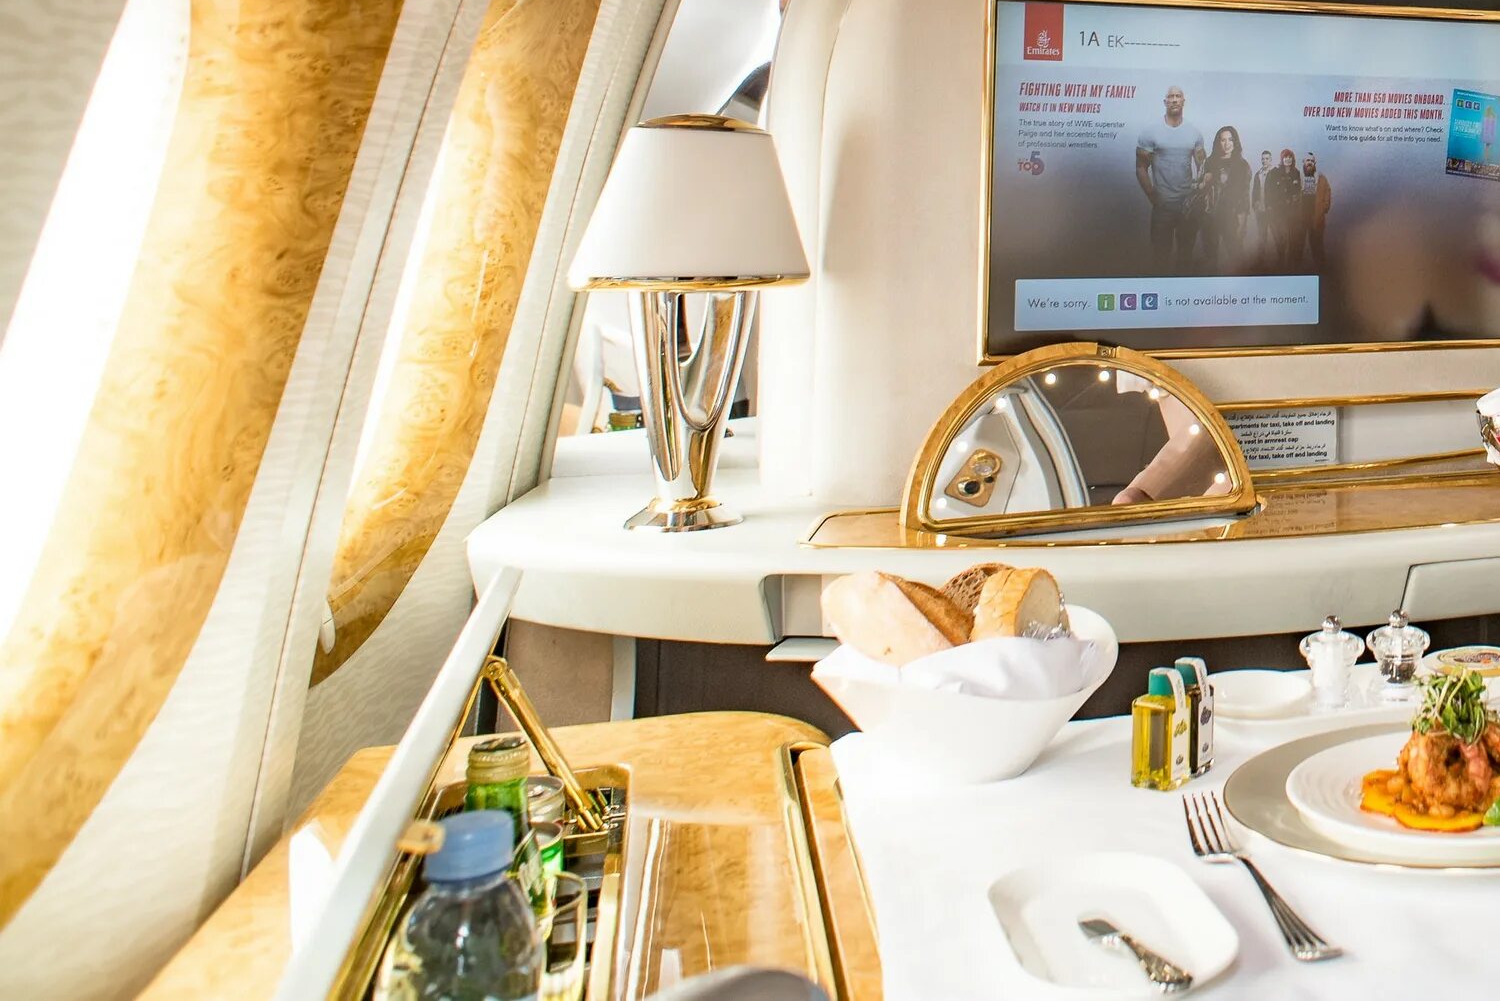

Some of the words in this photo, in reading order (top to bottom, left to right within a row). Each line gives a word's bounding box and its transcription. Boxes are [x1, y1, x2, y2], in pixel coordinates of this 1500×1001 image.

[1079, 31, 1100, 47] 1A
[1027, 46, 1060, 56] Emirates
[1019, 82, 1061, 97] FIGHTING
[1064, 83, 1088, 97] WITH
[1090, 84, 1103, 98] MY
[1105, 85, 1136, 98] FAMILY
[1334, 91, 1352, 102] MORE
[1354, 92, 1371, 103] THAN
[1387, 93, 1412, 104] MOVIES
[1414, 94, 1446, 105] ONBOARD.
[1019, 101, 1040, 112] WATCH
[1042, 102, 1049, 112] IT
[1050, 103, 1057, 112] IN
[1058, 103, 1074, 113] NEW
[1076, 103, 1101, 114] MOVIES
[1303, 106, 1320, 117] OVER
[1322, 107, 1335, 117] 100
[1337, 107, 1352, 118] NEW
[1354, 107, 1378, 118] MOVIES
[1380, 108, 1401, 119] ADDED
[1403, 109, 1418, 119] THIS
[1419, 109, 1444, 120] MONTH.
[1019, 119, 1032, 127] The
[1048, 120, 1065, 129] story
[1095, 121, 1126, 129] superstar
[1018, 130, 1038, 138] Paige
[1053, 130, 1065, 138] her
[1066, 130, 1096, 138] eccentric
[1097, 131, 1117, 140] family
[1026, 140, 1067, 149] professional
[1028, 298, 1060, 308] We're
[1165, 297, 1172, 306] is
[1175, 297, 1190, 306] not
[1193, 295, 1237, 306] available
[1240, 296, 1250, 305] at
[1253, 295, 1267, 304] the
[1270, 295, 1309, 304] moment.
